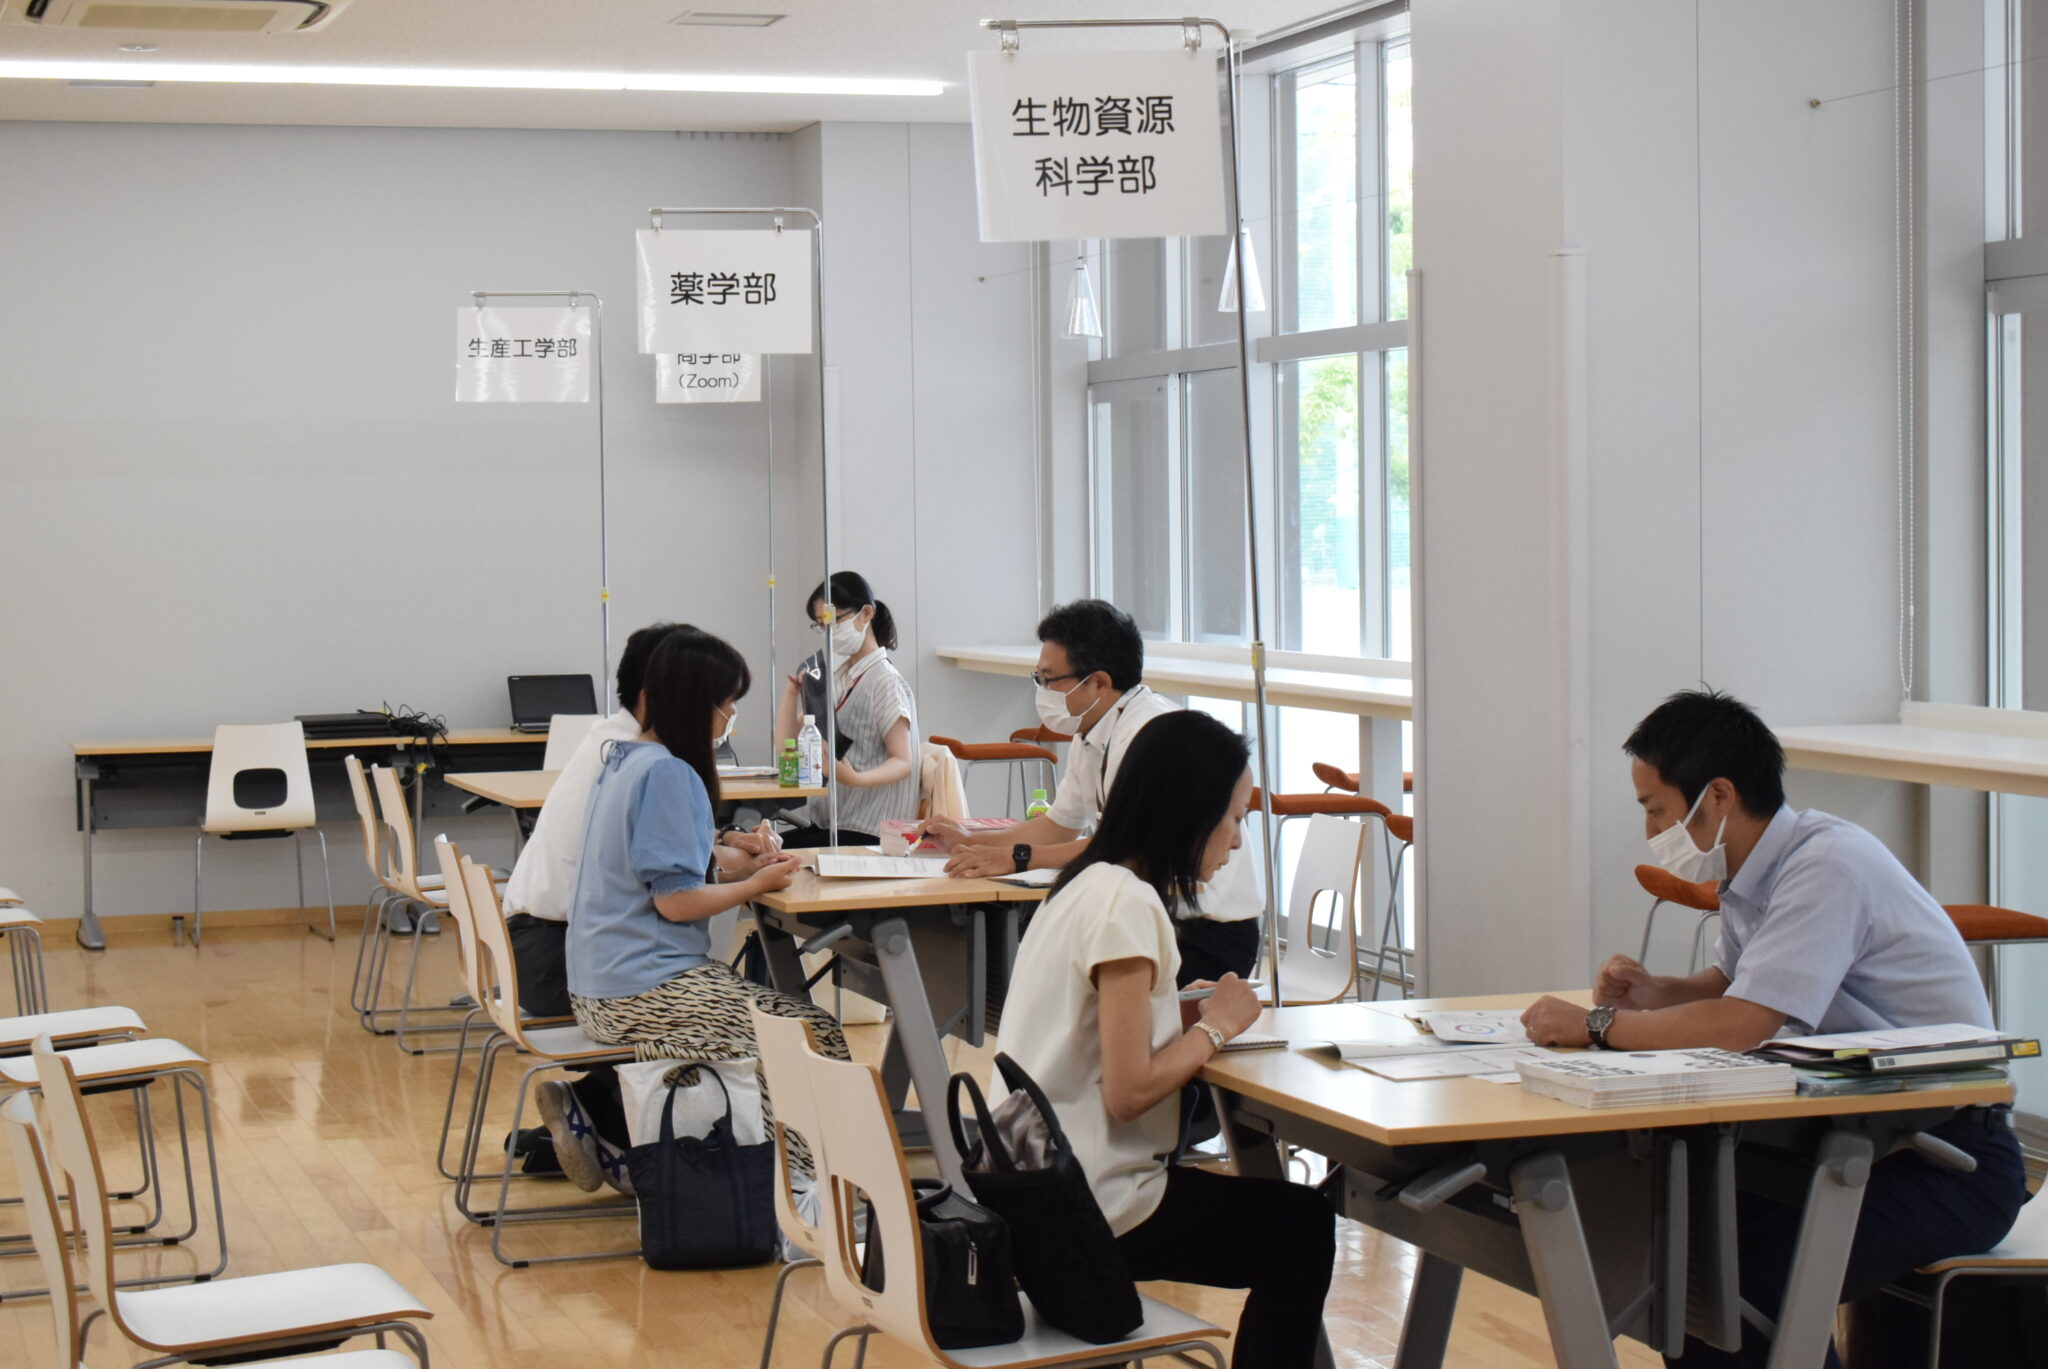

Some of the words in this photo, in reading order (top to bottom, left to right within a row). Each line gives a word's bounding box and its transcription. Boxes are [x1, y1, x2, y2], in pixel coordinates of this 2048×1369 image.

[1012, 95, 1175, 137] 生物資源
[1034, 154, 1156, 197] 科学部
[670, 271, 776, 305] 薬学部
[468, 337, 577, 359] 生産工学部
